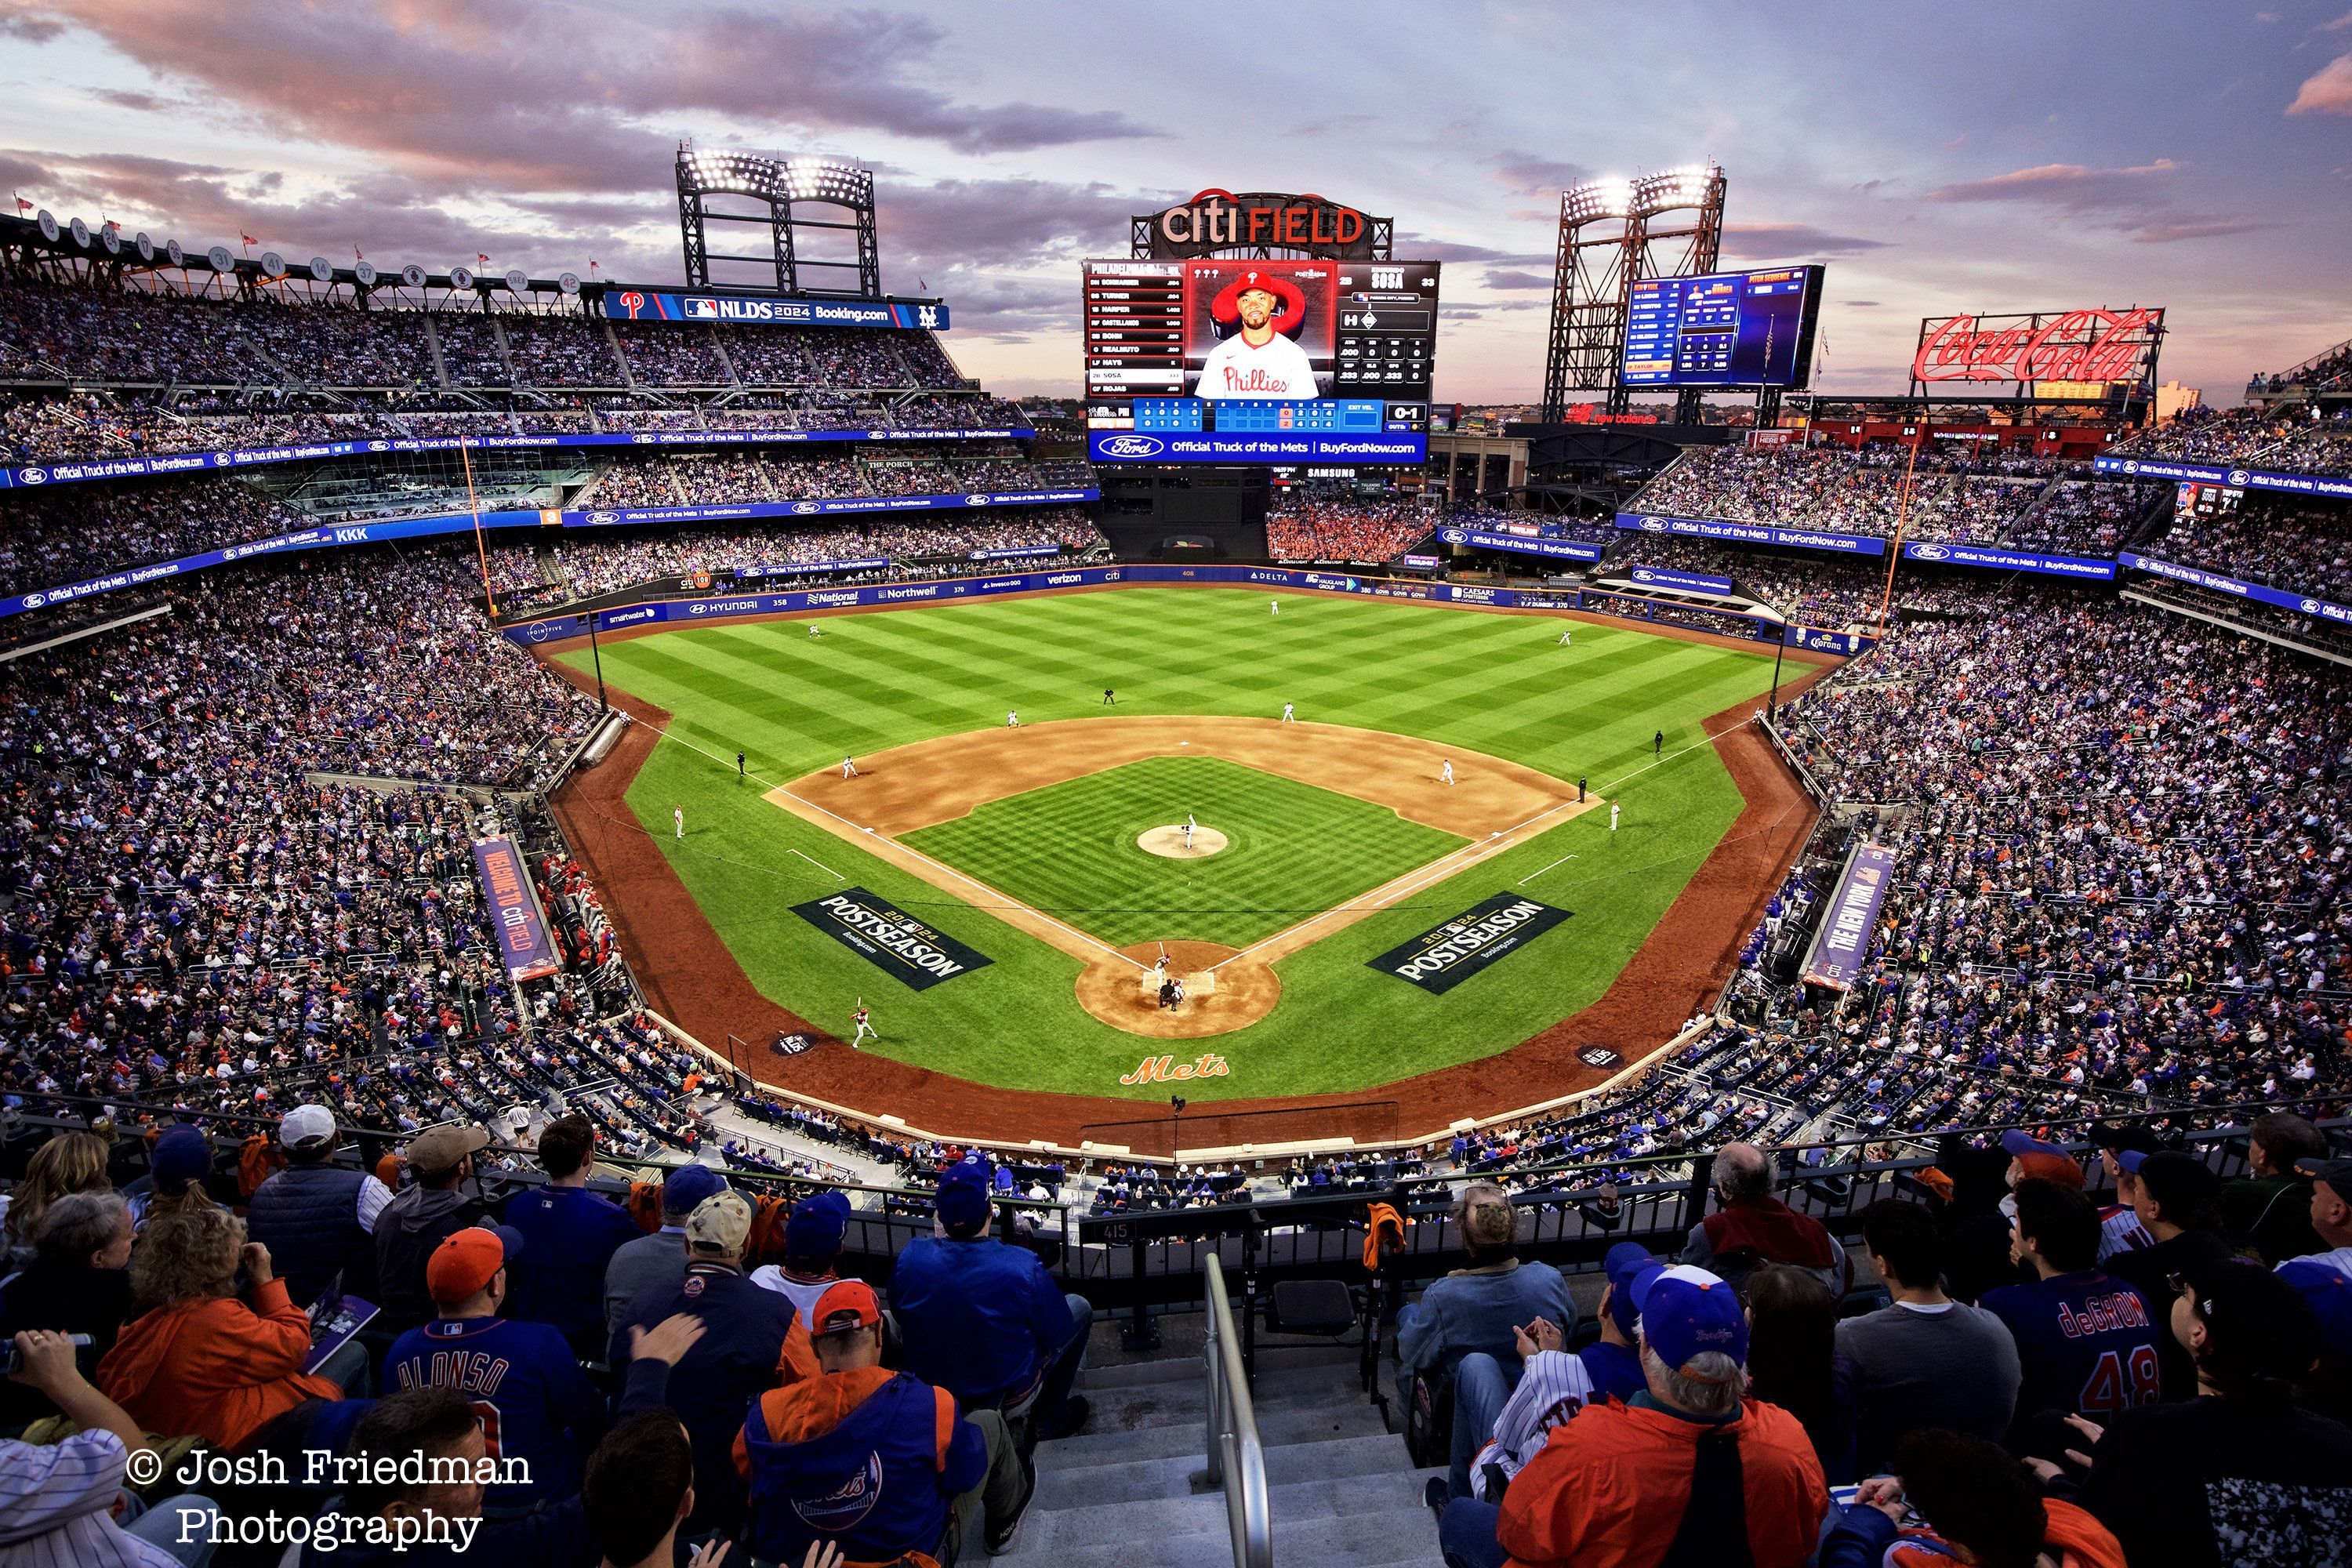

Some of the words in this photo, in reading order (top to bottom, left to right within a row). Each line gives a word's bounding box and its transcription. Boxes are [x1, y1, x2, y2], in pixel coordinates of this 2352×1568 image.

[44, 219, 53, 229] 18
[1250, 208, 1363, 244] FIELD
[78, 227, 86, 239] 16
[105, 232, 116, 246] 24
[141, 240, 148, 252] 17
[170, 247, 180, 259] 36
[216, 254, 229, 265] 31
[268, 258, 280, 270] 41
[316, 263, 327, 274] 14
[361, 267, 371, 278] 37
[564, 278, 577, 288] 42
[1371, 273, 1403, 289] SOSA
[1749, 274, 1764, 283] PITCH
[1764, 272, 1791, 282] SEQUENCE
[720, 300, 772, 320] NLDS
[775, 307, 810, 317] 2024
[816, 306, 887, 321] Booking.com
[1224, 367, 1287, 392] Phillies
[1395, 407, 1417, 419] 0-1
[1594, 415, 1614, 423] new
[1616, 413, 1658, 424] balance
[1172, 442, 1210, 452] Official
[1213, 442, 1243, 452] Truck
[1245, 442, 1258, 452] of
[1259, 442, 1278, 452] the
[1281, 443, 1308, 452] Mets
[1320, 443, 1415, 454] BuyFordNow.com
[53, 467, 82, 480] Official
[82, 465, 105, 477] Truck
[106, 465, 114, 474] of
[115, 463, 126, 474] the
[127, 462, 144, 473] Mets
[151, 458, 204, 471] BuyFordNow.com
[1308, 468, 1356, 477] SAMSUNG
[2201, 492, 2216, 503] SOSA
[546, 511, 557, 522] 3
[336, 528, 368, 543] KKK
[1672, 522, 1698, 532] Official
[1700, 525, 1720, 535] Truck
[1722, 527, 1733, 536] of
[1733, 527, 1747, 537] the
[1748, 529, 1769, 539] Mets
[1779, 532, 1857, 549] BuyFordNow.com
[1955, 551, 1977, 561] Official
[2007, 557, 2019, 565] the
[2045, 561, 2110, 574] BuyFordNow.com
[49, 587, 74, 601] Official
[74, 586, 92, 597] Truck
[93, 582, 100, 592] of
[100, 580, 111, 590] the
[111, 576, 126, 588] Mets
[132, 564, 179, 582] BuyFordNow.com
[1047, 574, 1081, 585] verizon
[1105, 572, 1120, 581] citi
[1260, 572, 1287, 582] DELTA
[887, 586, 936, 598] Northwell
[710, 601, 757, 612] HYUNDAI
[609, 610, 645, 624] smartwater
[526, 625, 562, 636] 1POINTFIVE
[1722, 631, 1753, 640] CADILLAC
[1811, 637, 1841, 650] Corona
[485, 850, 519, 895] WELCOME
[1855, 867, 1881, 885] Mets
[497, 894, 524, 906] TO
[1844, 882, 1876, 908] YORK
[502, 907, 529, 927] citi
[1835, 906, 1867, 932] NEW
[884, 910, 904, 921] 20
[918, 929, 938, 940] 24
[1422, 932, 1443, 945] 20
[1457, 914, 1477, 925] 24
[507, 924, 533, 951] FIELD
[819, 895, 964, 978] POSTSEASON
[843, 931, 877, 954] Booking.com
[1396, 901, 1544, 981] POSTSEASON
[1827, 929, 1861, 952] THE
[1481, 937, 1518, 959] Booking.com
[1120, 1054, 1230, 1085] Mets
[1104, 1224, 1127, 1238] 415
[2057, 1290, 2151, 1338] deGROM
[397, 1350, 510, 1397] ALONSO
[2079, 1343, 2161, 1413] 48
